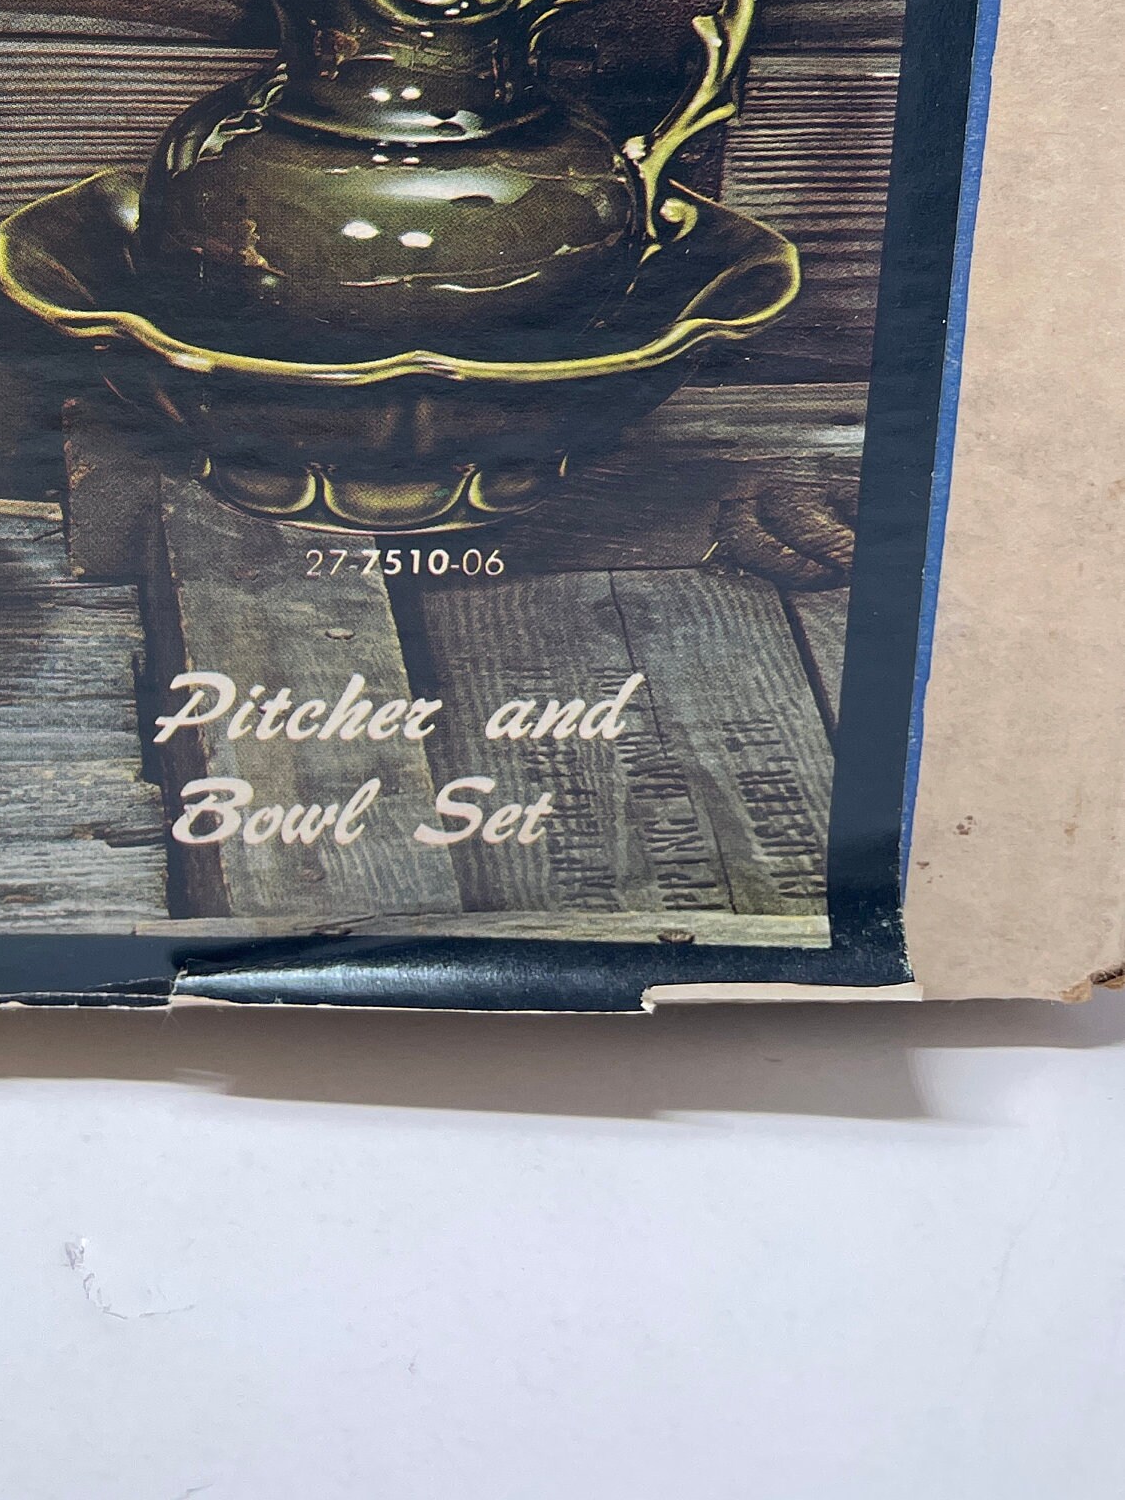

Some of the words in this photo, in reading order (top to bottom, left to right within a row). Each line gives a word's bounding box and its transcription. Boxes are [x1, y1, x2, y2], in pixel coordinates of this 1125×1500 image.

[305, 549, 506, 577] 27-7510-06
[153, 671, 443, 743] Pitcher
[485, 671, 646, 740] and
[171, 776, 382, 847] Bowl
[414, 775, 554, 845] Set
